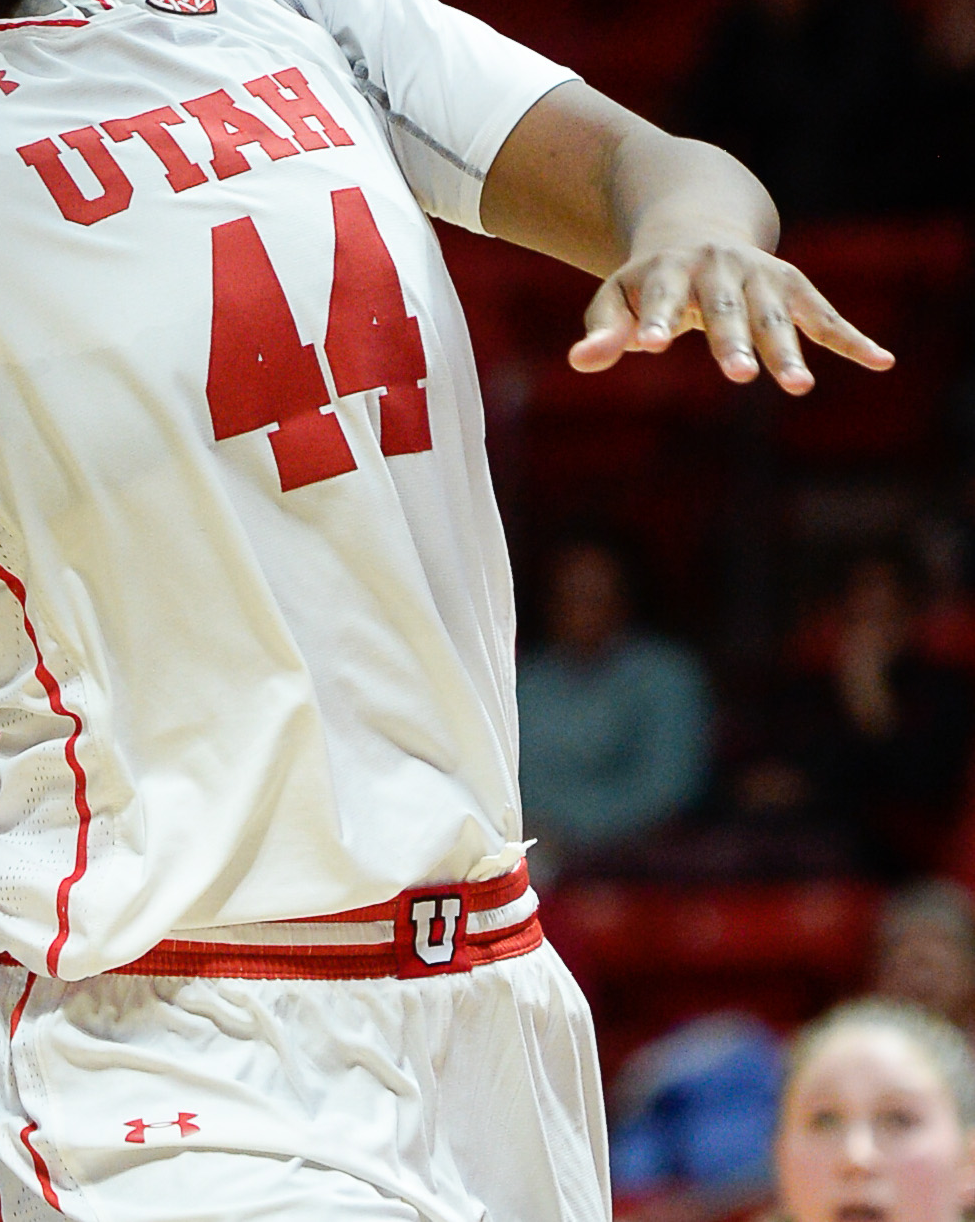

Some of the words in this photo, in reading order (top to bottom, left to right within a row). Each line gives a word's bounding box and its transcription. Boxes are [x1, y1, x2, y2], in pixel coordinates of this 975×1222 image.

[15, 67, 354, 226] UTAH
[206, 186, 432, 493] 44
[412, 897, 461, 966] U
